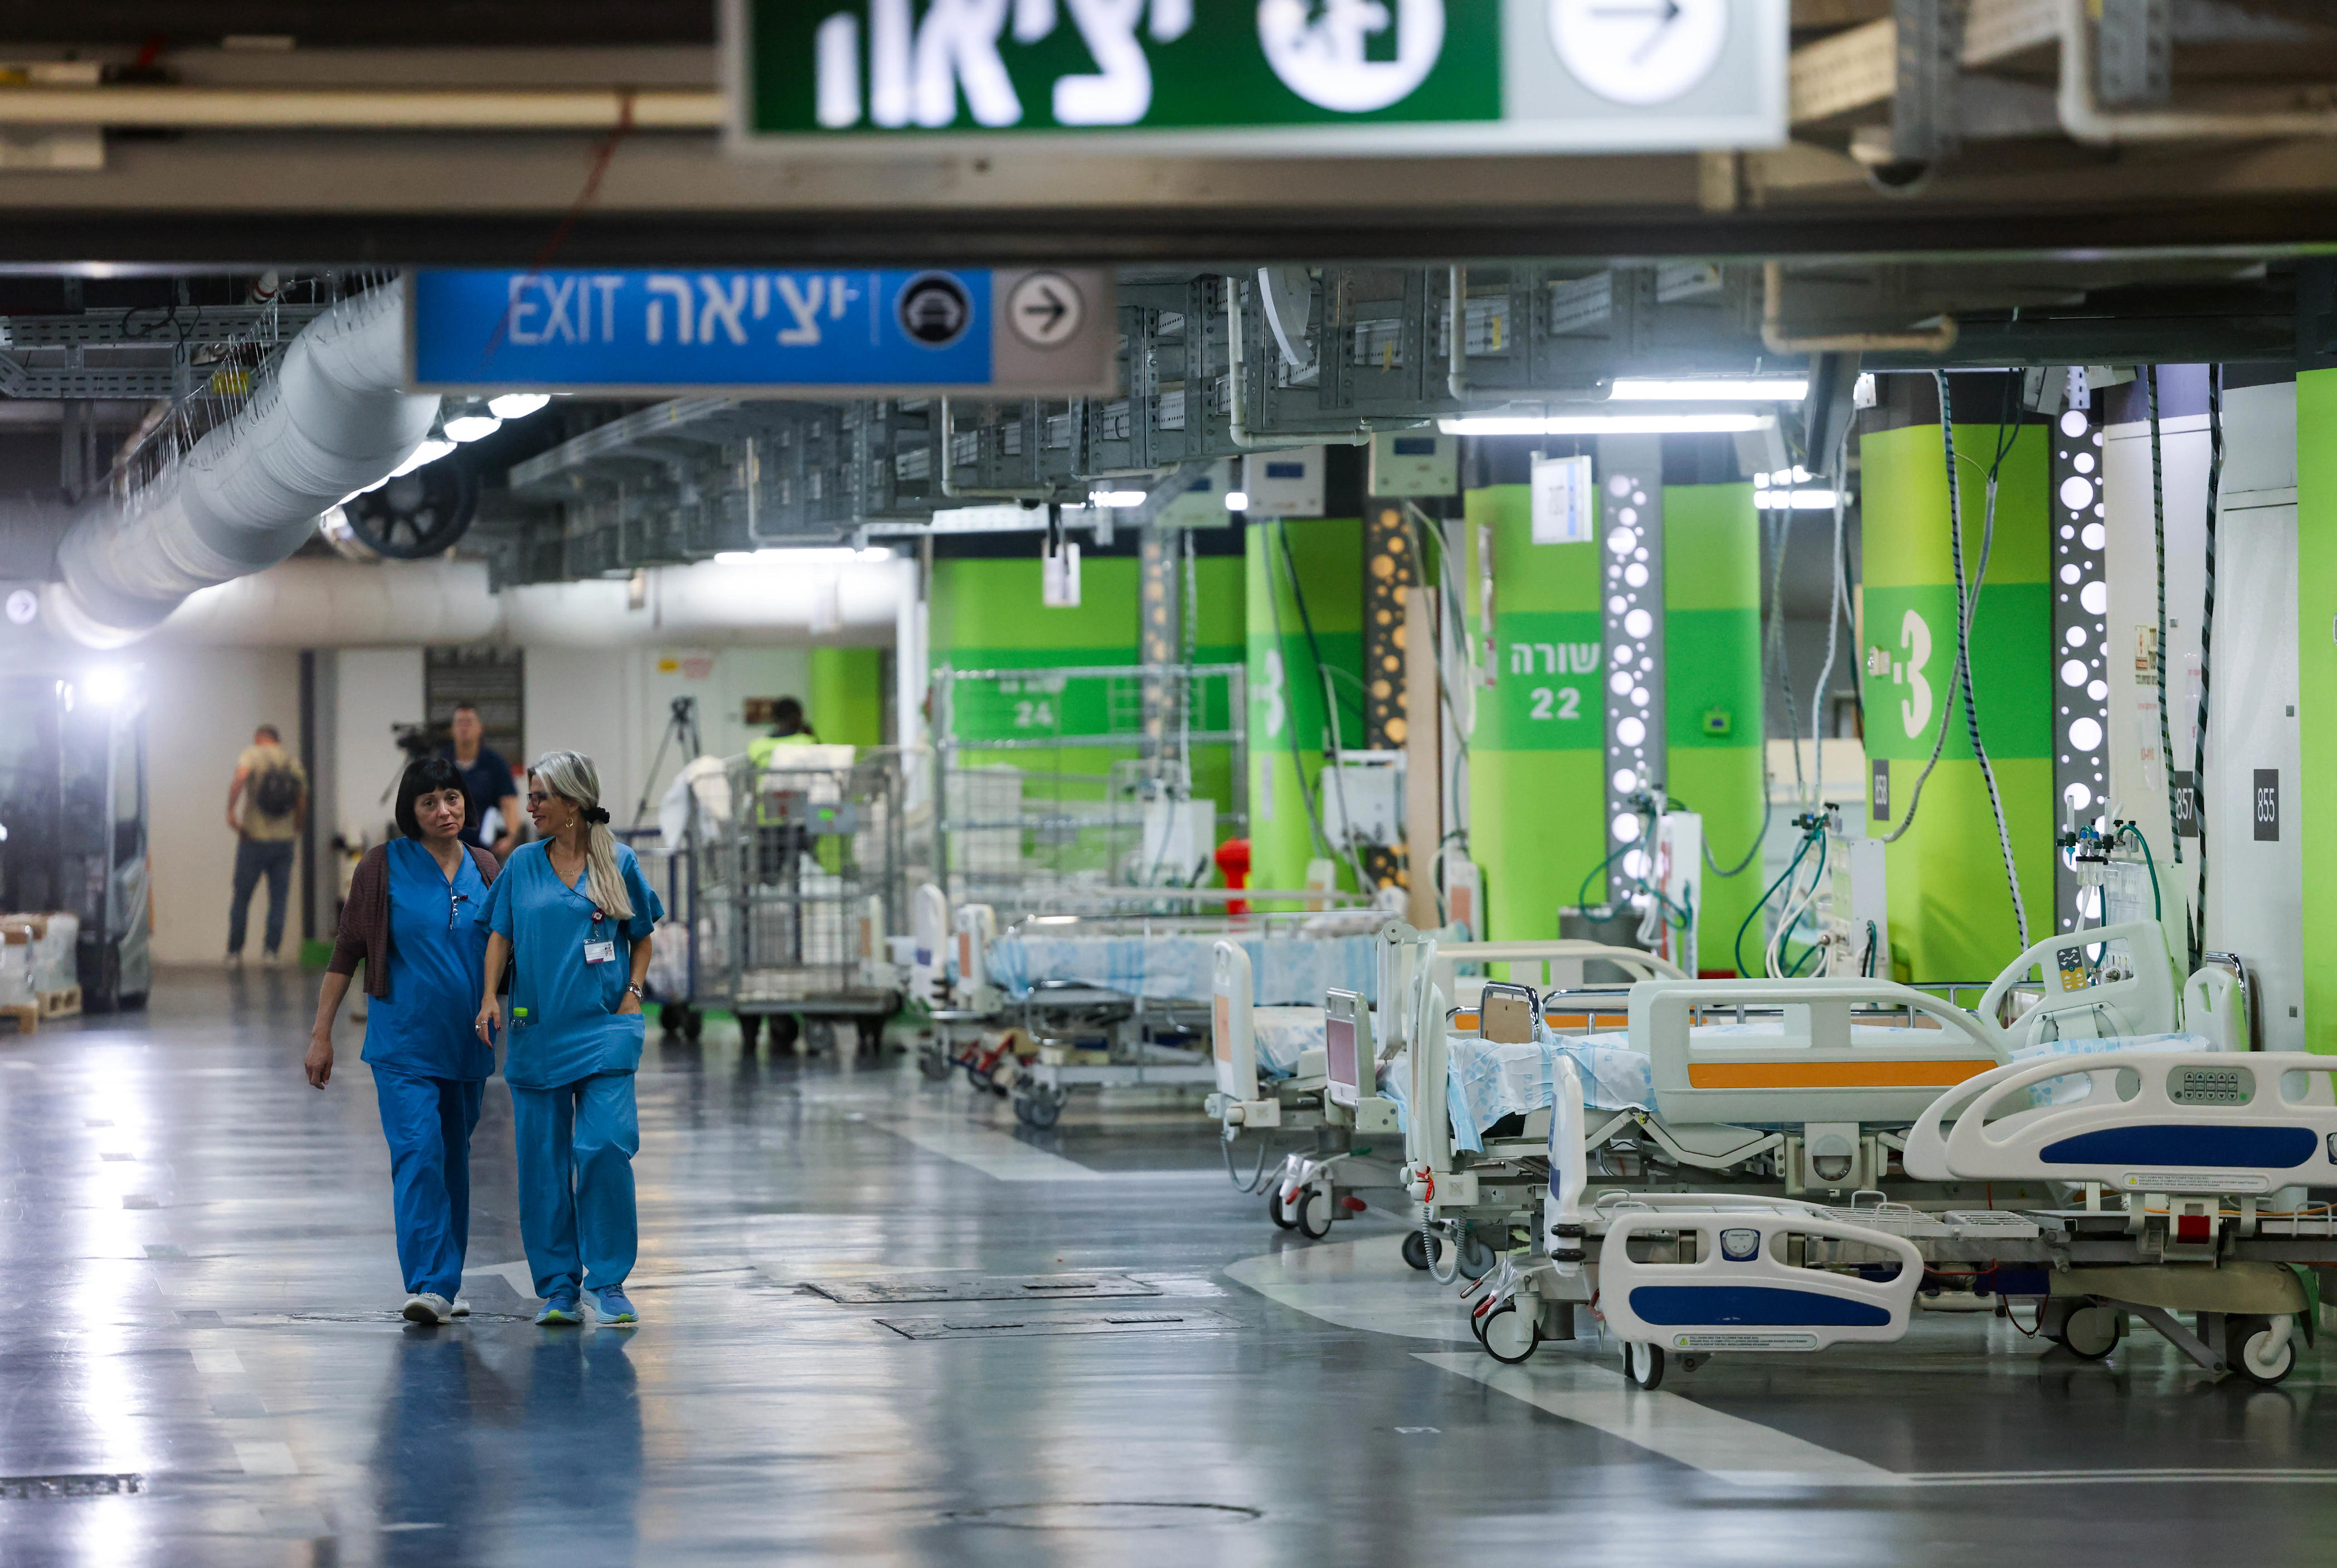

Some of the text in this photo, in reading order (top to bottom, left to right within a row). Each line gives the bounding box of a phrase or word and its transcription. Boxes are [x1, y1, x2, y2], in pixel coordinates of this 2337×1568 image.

[508, 274, 624, 345] EXIT
[645, 275, 846, 346] יציאה
[1510, 642, 1601, 674] שורה
[1014, 701, 1053, 727] 24
[1530, 687, 1581, 720] 22
[2176, 788, 2194, 820] 857
[2257, 787, 2275, 822] 855
